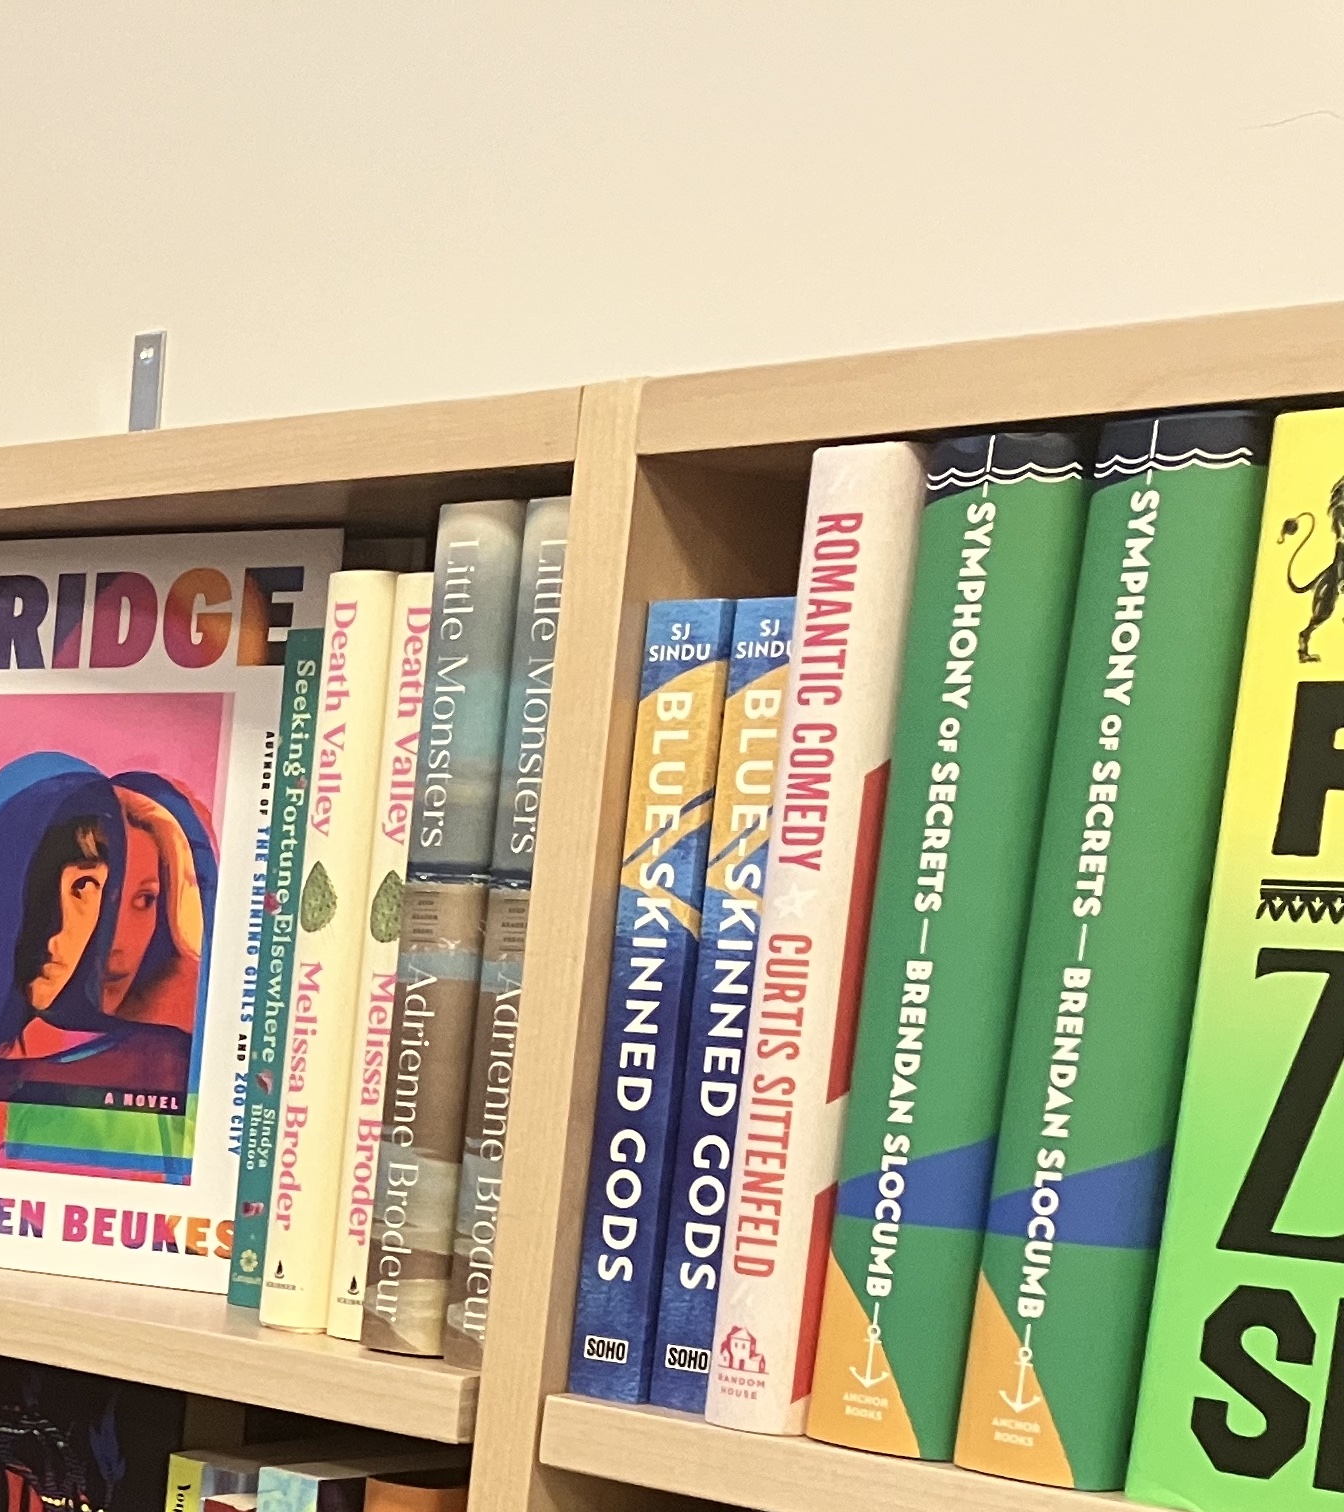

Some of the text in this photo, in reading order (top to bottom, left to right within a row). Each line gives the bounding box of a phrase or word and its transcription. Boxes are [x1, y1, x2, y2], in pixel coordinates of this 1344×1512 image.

[440, 540, 479, 641] Little
[648, 643, 712, 662] SINDU
[670, 622, 691, 643] SJ
[758, 618, 780, 637] SJ
[310, 600, 358, 837] Death Valley
[382, 607, 433, 847] Death Valley
[420, 655, 469, 848] Monsters
[777, 512, 864, 872] ROMANTIC COMEDY
[914, 501, 997, 913] SYMPHONY OF SECRETS
[1073, 489, 1160, 919] SYMPHONY OF SECRETS
[615, 691, 693, 1112] BLUE-SKINNED
[700, 688, 782, 1118] BLUE-SKINNED
[104, 1092, 179, 1111] A NOVEL
[275, 960, 324, 1231] Melissa Broder
[348, 972, 398, 1246] Melissa Broder
[391, 965, 437, 1149] Adrienne
[733, 933, 813, 1278] CURTIS SITTENFELD
[865, 958, 933, 1298] BRENDAN SLOCUMB
[1016, 967, 1092, 1320] BRENDAN SLOCUMB
[62, 1205, 236, 1259] BEUKES
[376, 1161, 419, 1323] Brodeur
[597, 1128, 648, 1283] GODS
[679, 1134, 731, 1291] GODS
[717, 1372, 766, 1389] RANDOM
[720, 1385, 758, 1400] HOUSE
